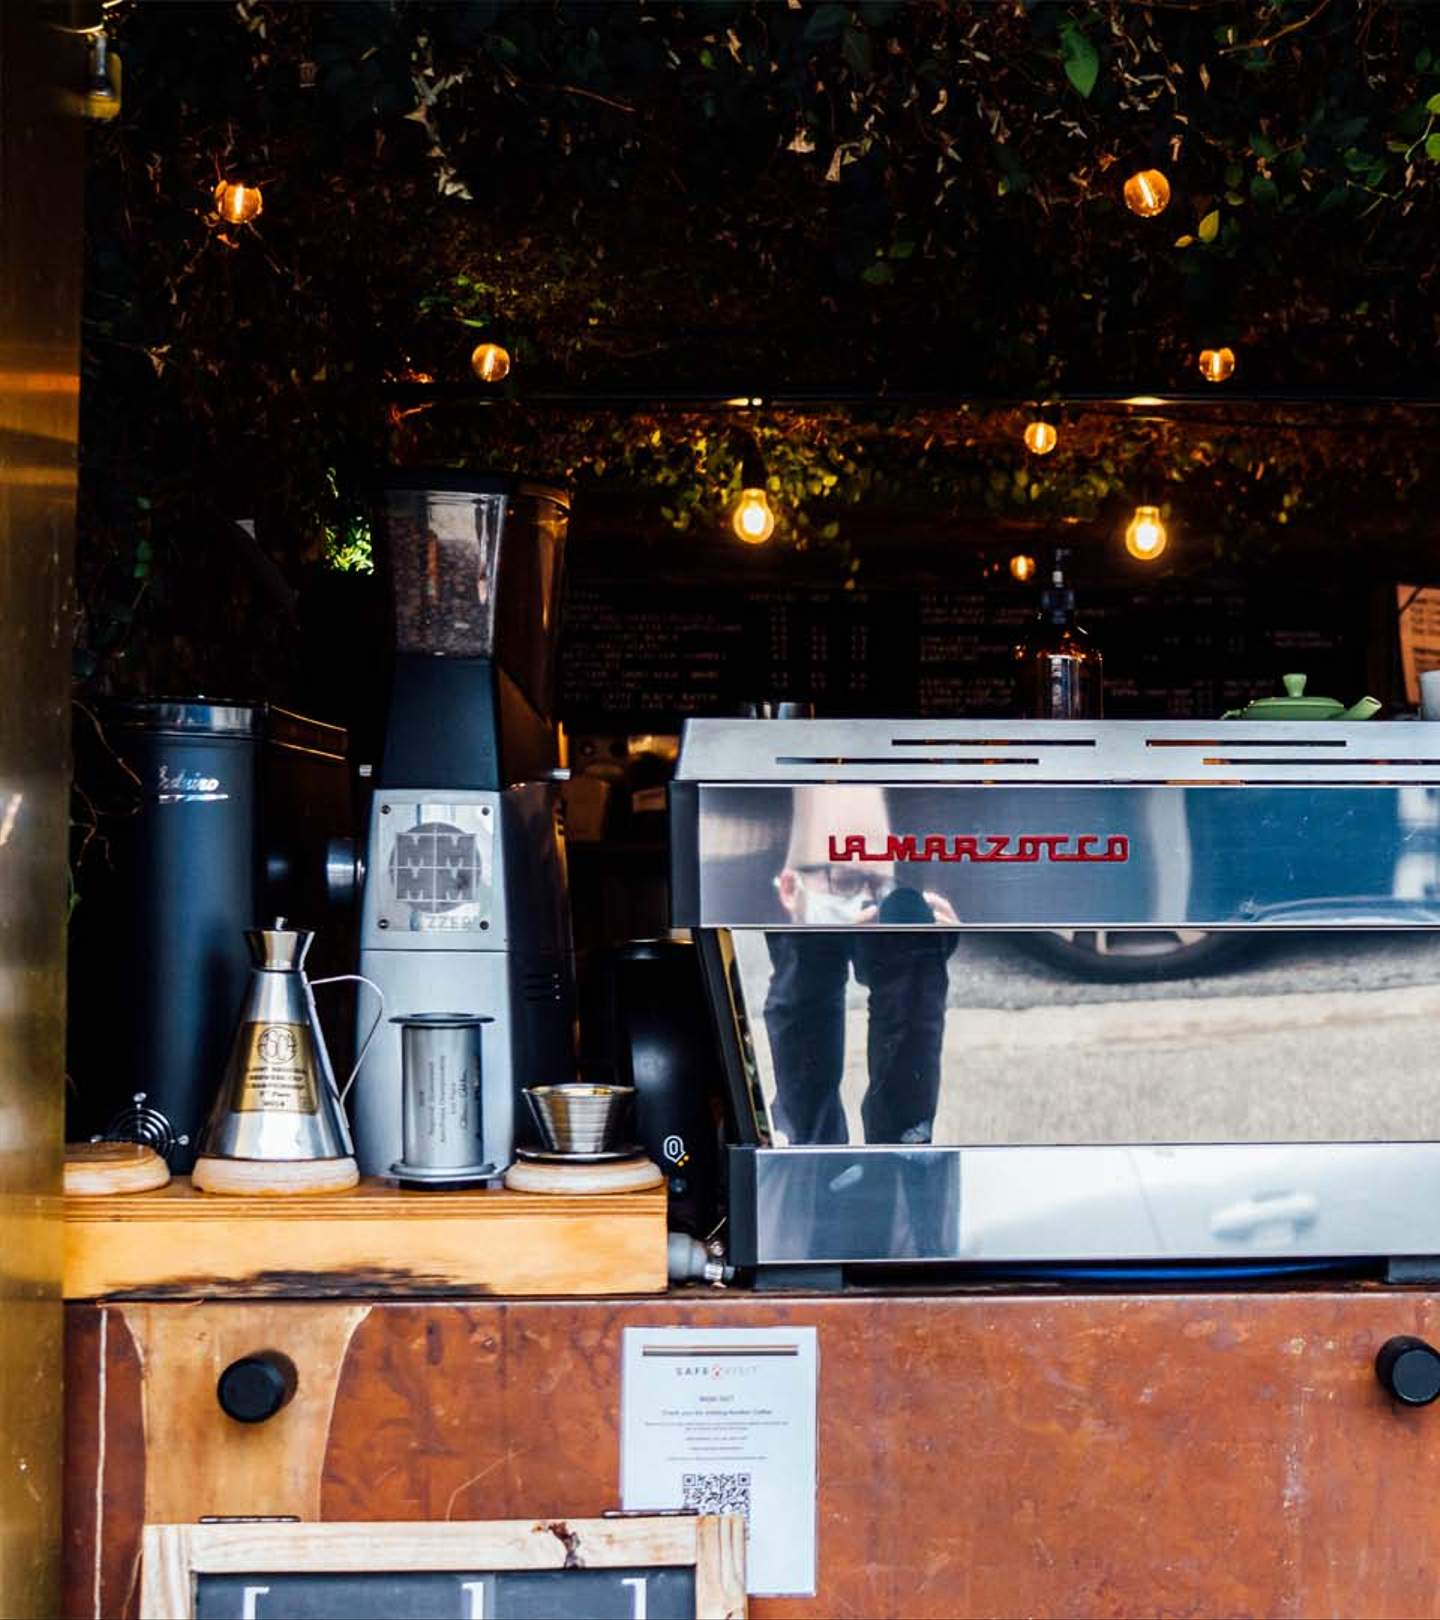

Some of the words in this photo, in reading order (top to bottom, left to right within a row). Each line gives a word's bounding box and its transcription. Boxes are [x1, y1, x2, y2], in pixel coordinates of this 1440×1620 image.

[828, 835, 867, 862] LA
[886, 835, 1129, 862] MARZOCCO
[676, 1367, 709, 1376] SAFE
